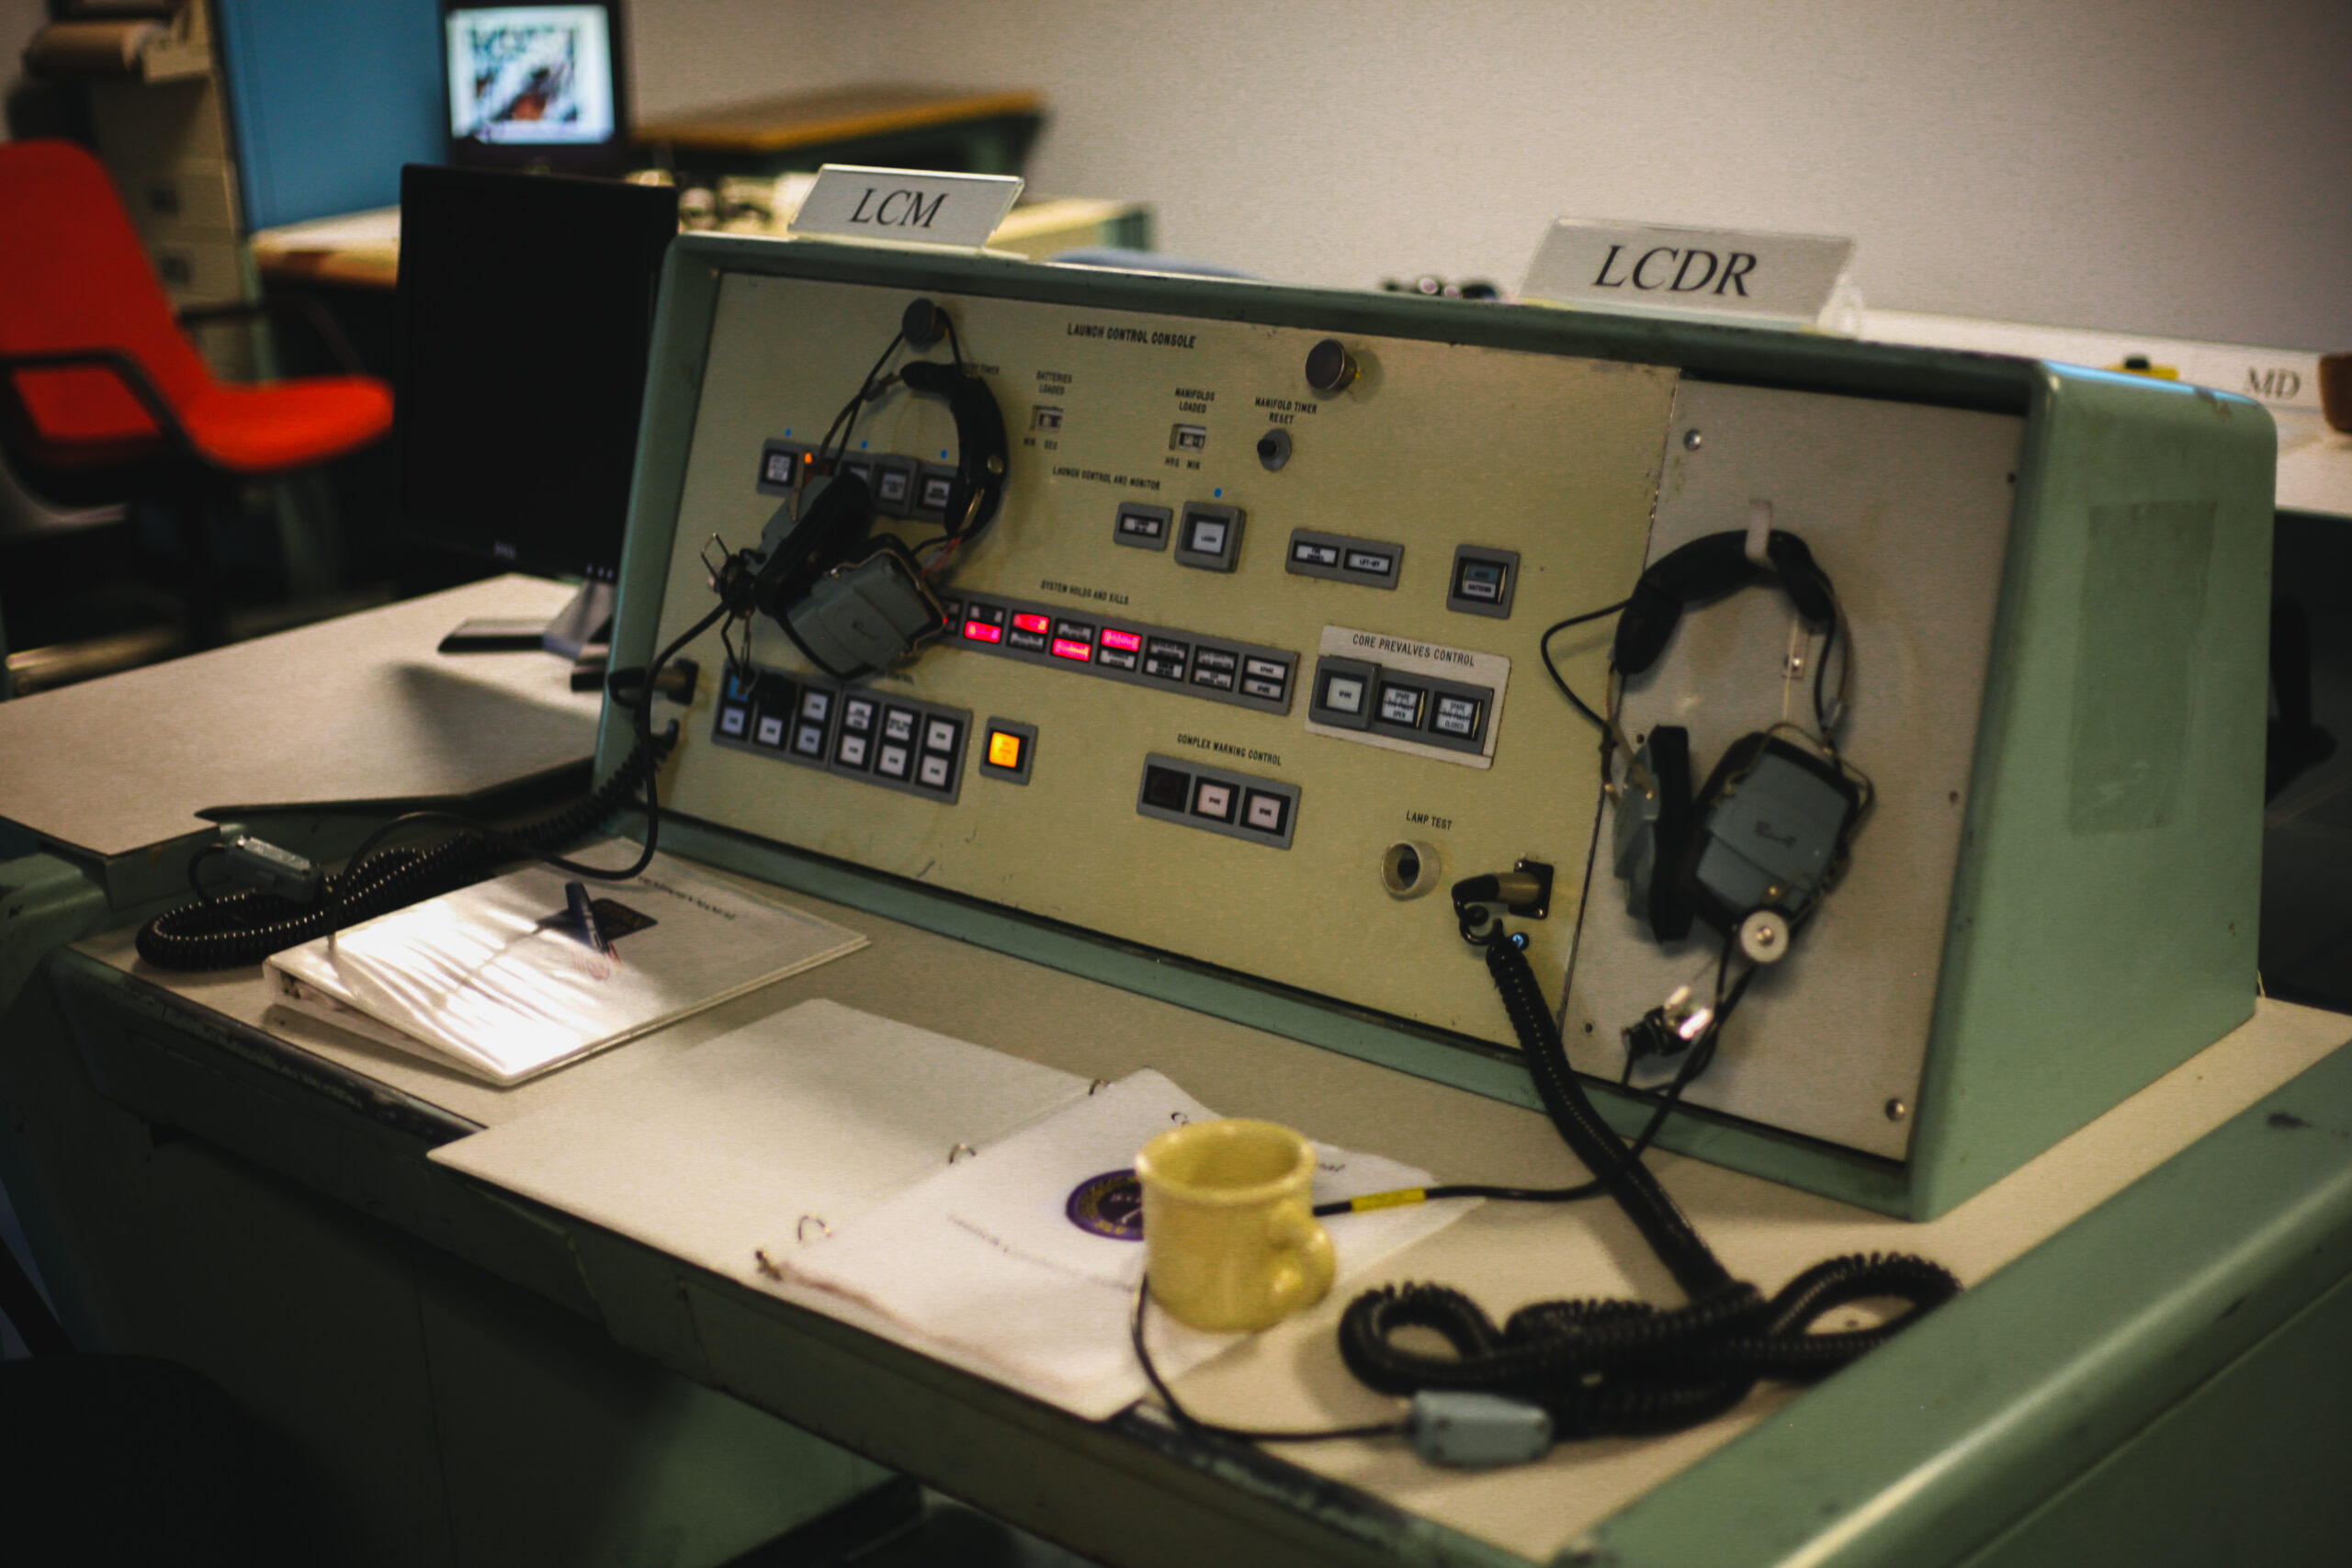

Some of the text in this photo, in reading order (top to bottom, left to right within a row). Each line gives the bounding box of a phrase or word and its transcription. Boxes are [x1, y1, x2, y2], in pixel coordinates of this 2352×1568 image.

[849, 187, 949, 228] LCM
[1590, 244, 1758, 297] LCDR
[1068, 322, 1195, 348] LAUNCH CONTROL CONSOLE
[1036, 370, 1072, 384] BATTERIES
[2244, 366, 2301, 400] MD
[1039, 384, 1065, 396] LOADED
[1175, 388, 1215, 401] MANIFOLDS
[1179, 401, 1206, 413] LOADED
[1255, 397, 1317, 414] MANIFOLD TIMER
[1269, 412, 1295, 424] RESET
[1052, 466, 1160, 491] LAUNCH CONTROL AND MONITOR
[1041, 580, 1129, 605] SYSTEM HOLDS AND KILLS
[1352, 633, 1475, 667] CORE PREVALVES CONTROL
[1395, 691, 1410, 701] SPARE
[1393, 710, 1406, 719] OPEN
[1444, 720, 1464, 730] CLOSED
[1177, 733, 1282, 766] COMPLEX WARNING CONTROL
[1406, 810, 1453, 830] LAMP TEST
